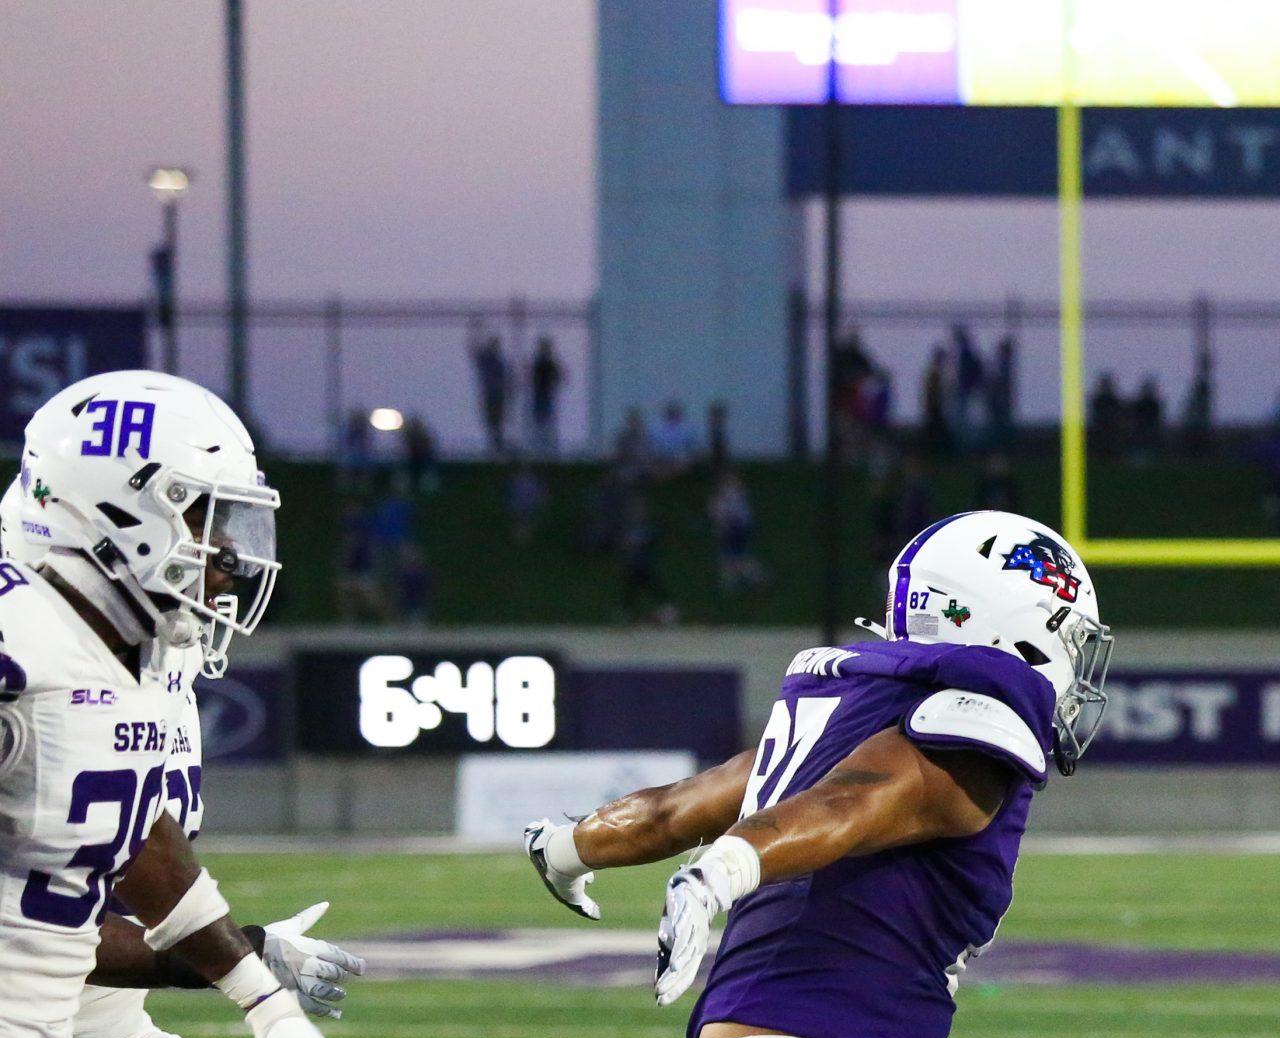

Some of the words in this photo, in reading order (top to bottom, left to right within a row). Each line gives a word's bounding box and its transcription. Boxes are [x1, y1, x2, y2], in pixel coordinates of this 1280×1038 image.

[909, 591, 930, 610] 87
[71, 689, 114, 705] SLC
[359, 655, 557, 748] 6:48
